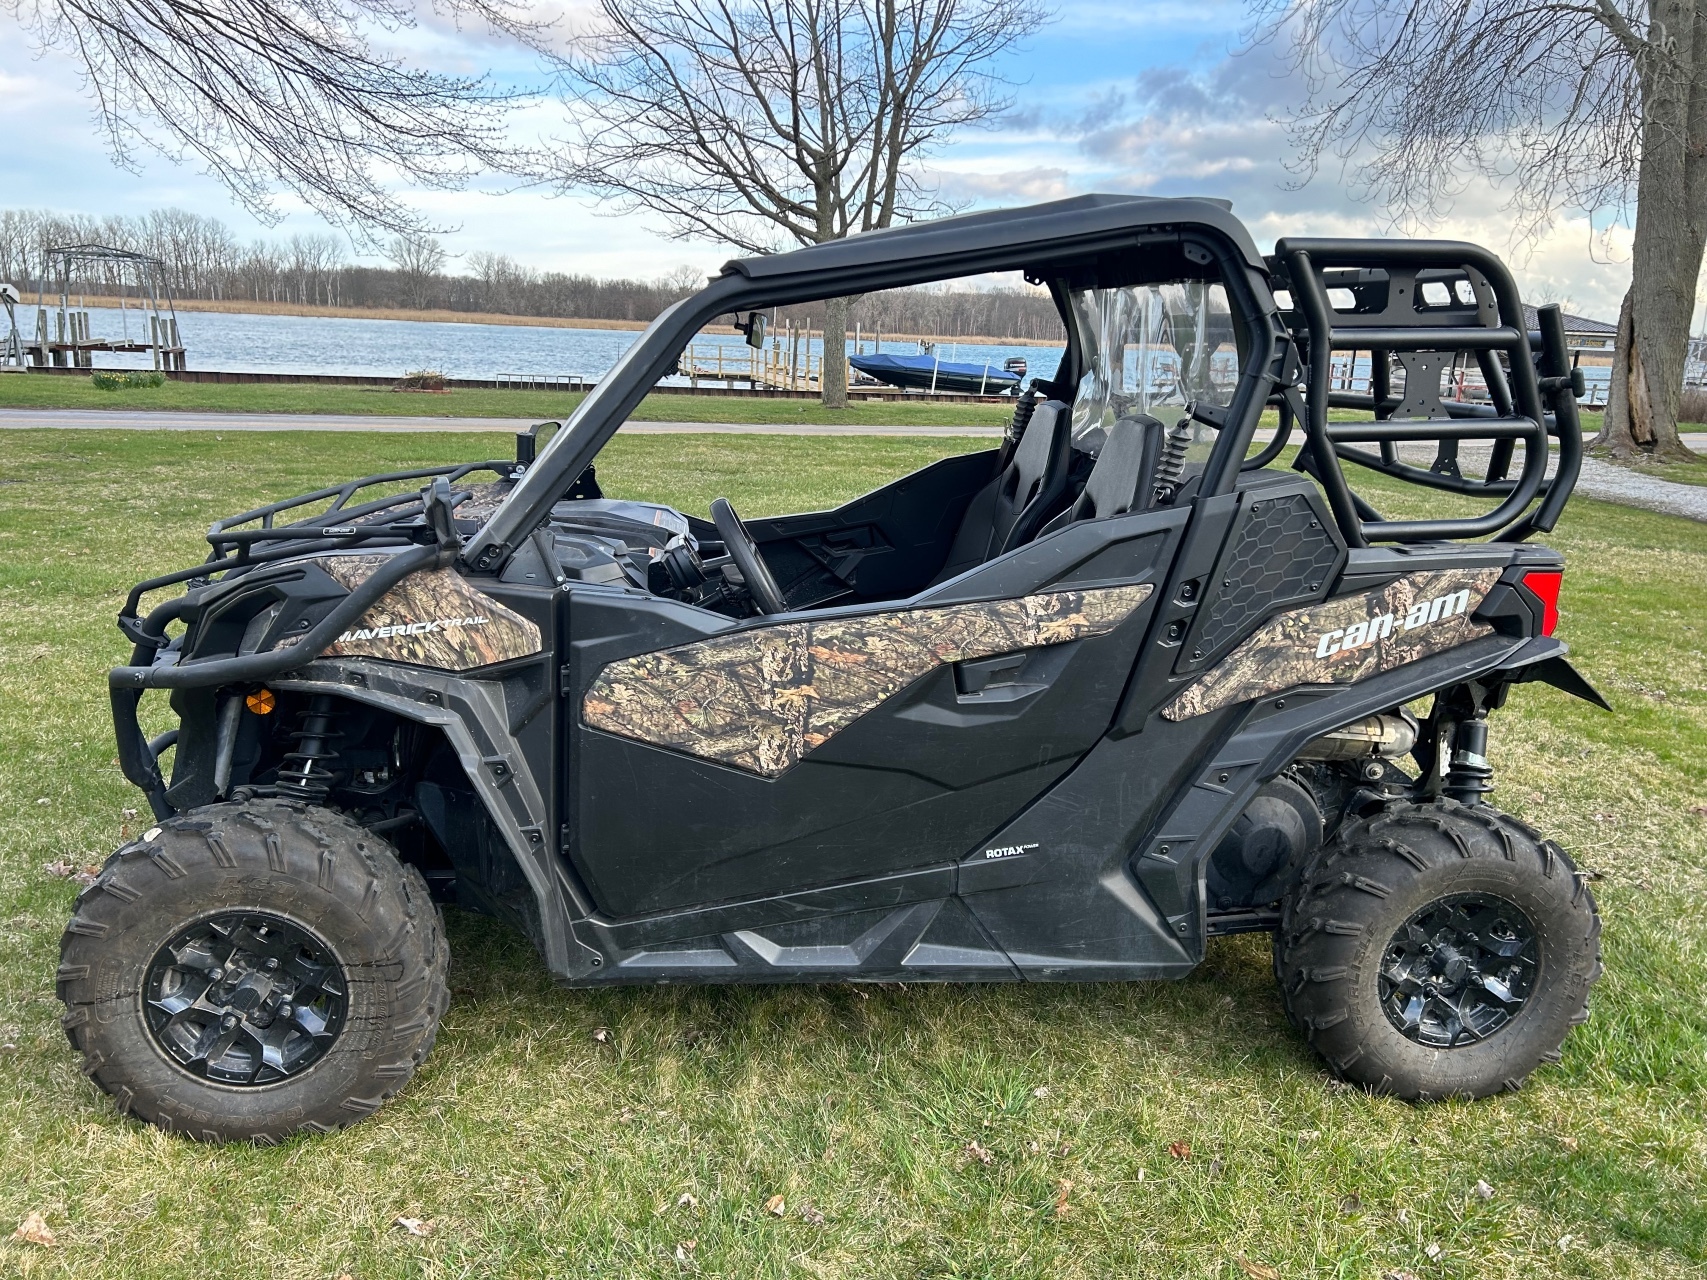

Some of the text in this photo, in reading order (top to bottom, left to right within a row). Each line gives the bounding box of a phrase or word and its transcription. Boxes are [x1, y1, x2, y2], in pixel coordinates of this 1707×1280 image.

[335, 615, 490, 643] MAVERICK TRAIL
[1315, 588, 1470, 659] can-am
[985, 845, 1024, 859] ROTAX
[1346, 921, 1378, 1029] CARLISLE
[157, 1094, 304, 1128] CARLISLE
